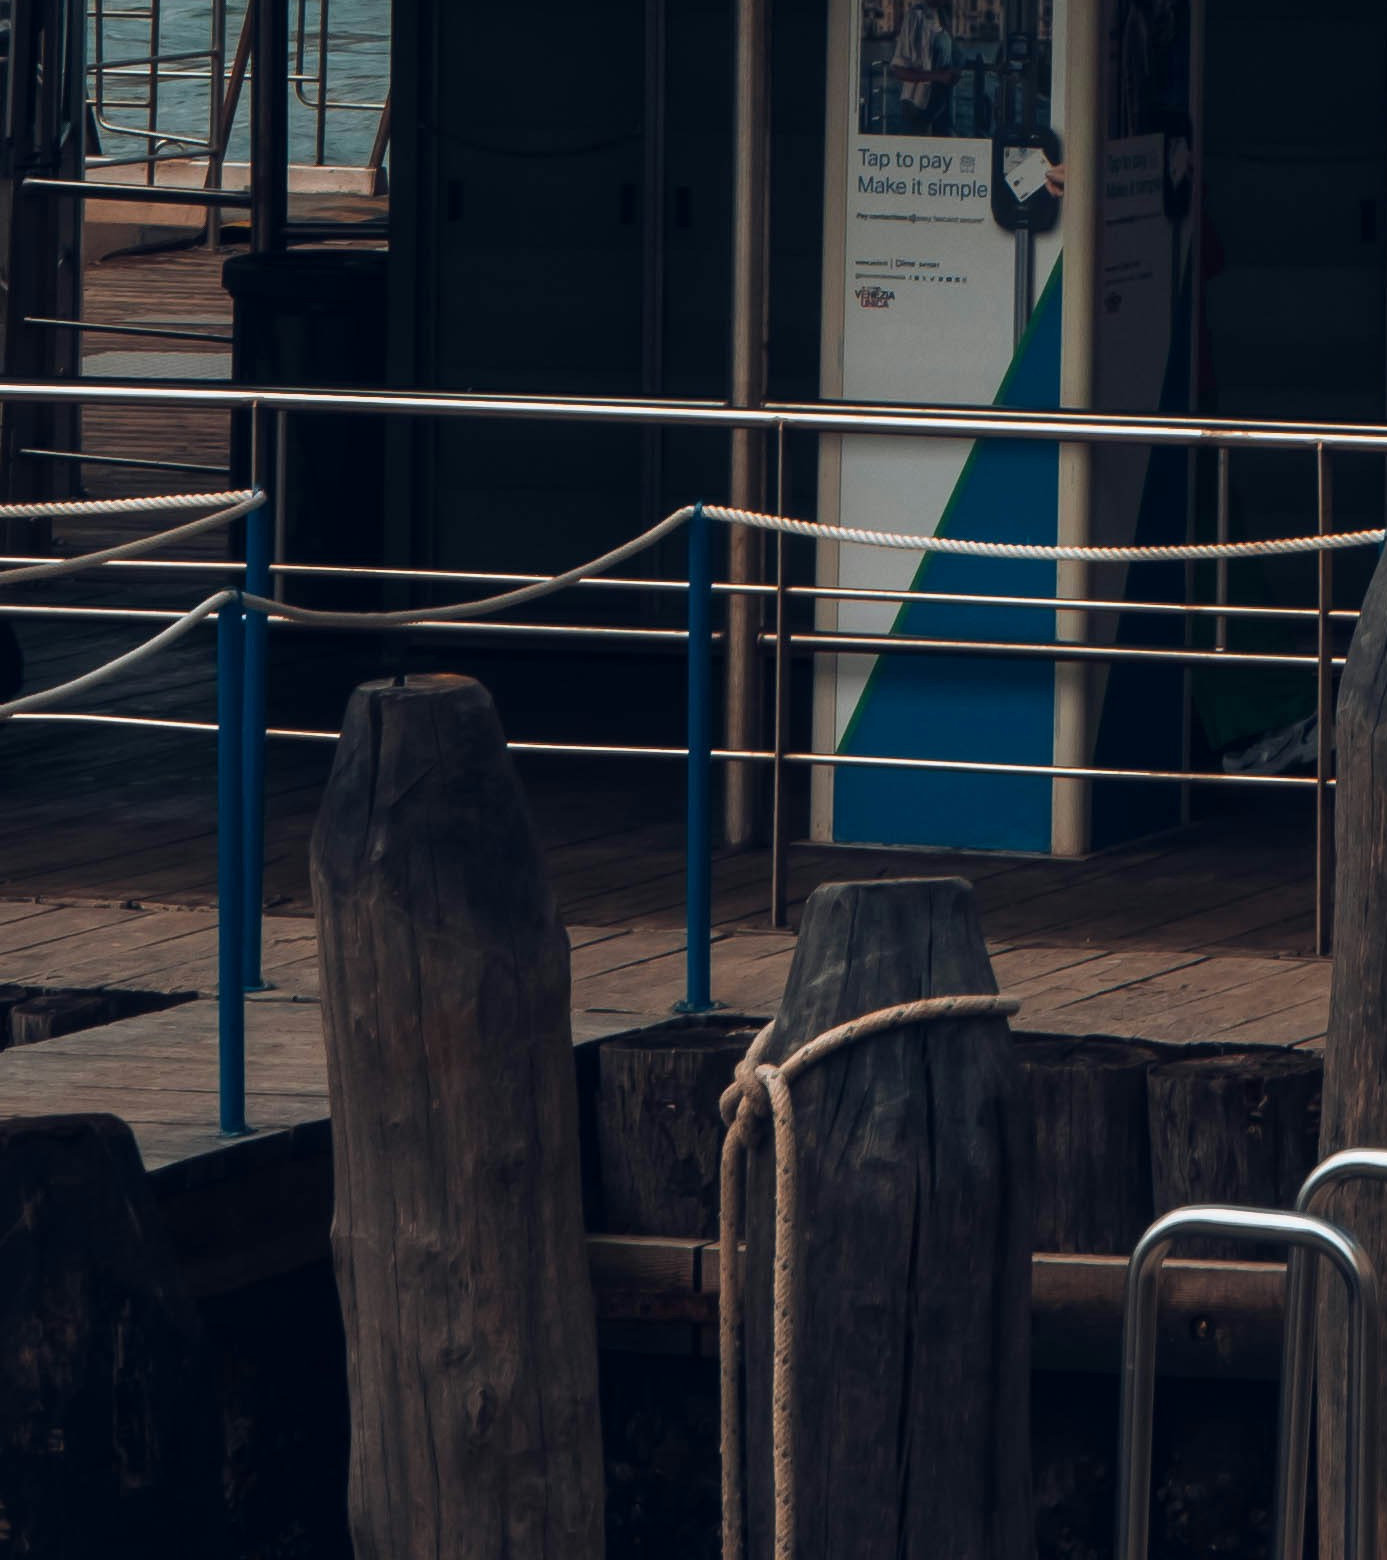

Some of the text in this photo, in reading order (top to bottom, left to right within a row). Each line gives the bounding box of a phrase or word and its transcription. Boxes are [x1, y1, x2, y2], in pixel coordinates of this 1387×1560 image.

[858, 148, 953, 173] Tap to pay
[858, 175, 988, 201] Make it simple
